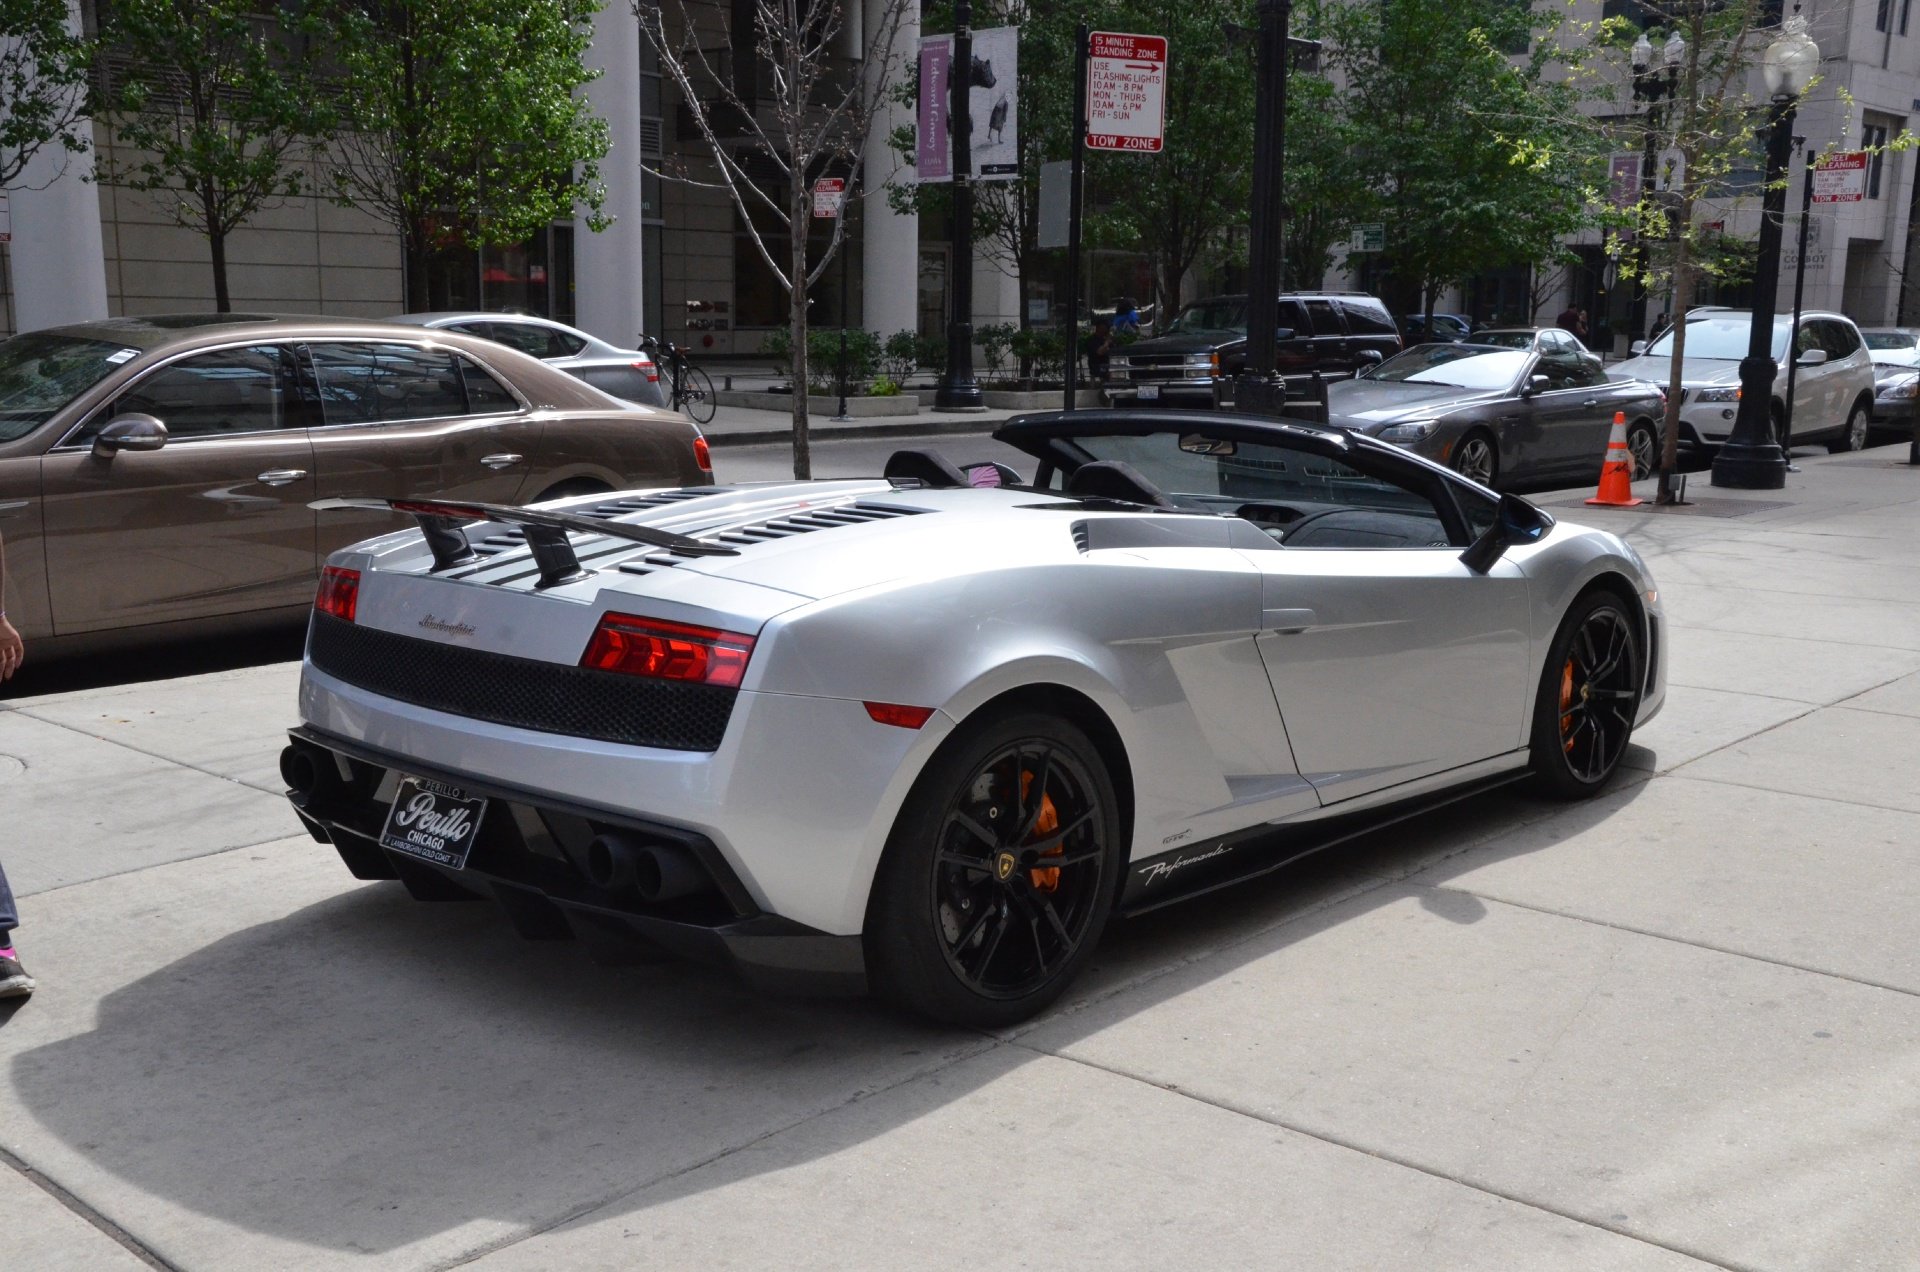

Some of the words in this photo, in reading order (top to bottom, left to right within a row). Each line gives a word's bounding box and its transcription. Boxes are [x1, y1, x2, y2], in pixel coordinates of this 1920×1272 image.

[1095, 36, 1103, 45] 15
[1105, 37, 1135, 48] MINUTE
[1095, 46, 1133, 57] STANDING
[1137, 49, 1158, 59] ZONE
[1094, 61, 1110, 71] USE
[930, 57, 940, 107] Edward
[1093, 71, 1132, 82] FLASHING
[1133, 75, 1161, 84] LIGHTS
[1123, 83, 1129, 91] 8
[1131, 84, 1144, 92] PM
[1092, 91, 1111, 100] MON
[1120, 92, 1147, 102] THURS
[1122, 102, 1128, 110] 6
[1129, 103, 1142, 111] PM
[1092, 111, 1106, 119] FRI
[1113, 111, 1130, 120] SUN
[1091, 135, 1117, 147] TOW
[1123, 137, 1155, 149] ZONE
[425, 780, 461, 798] PERILLO
[395, 792, 471, 842] Perillo
[407, 830, 445, 849] CHICAGO
[390, 839, 422, 855] LAMBORGHINI
[421, 848, 435, 859] GOLD
[434, 851, 452, 863] COAST
[1137, 842, 1233, 887] Performante
